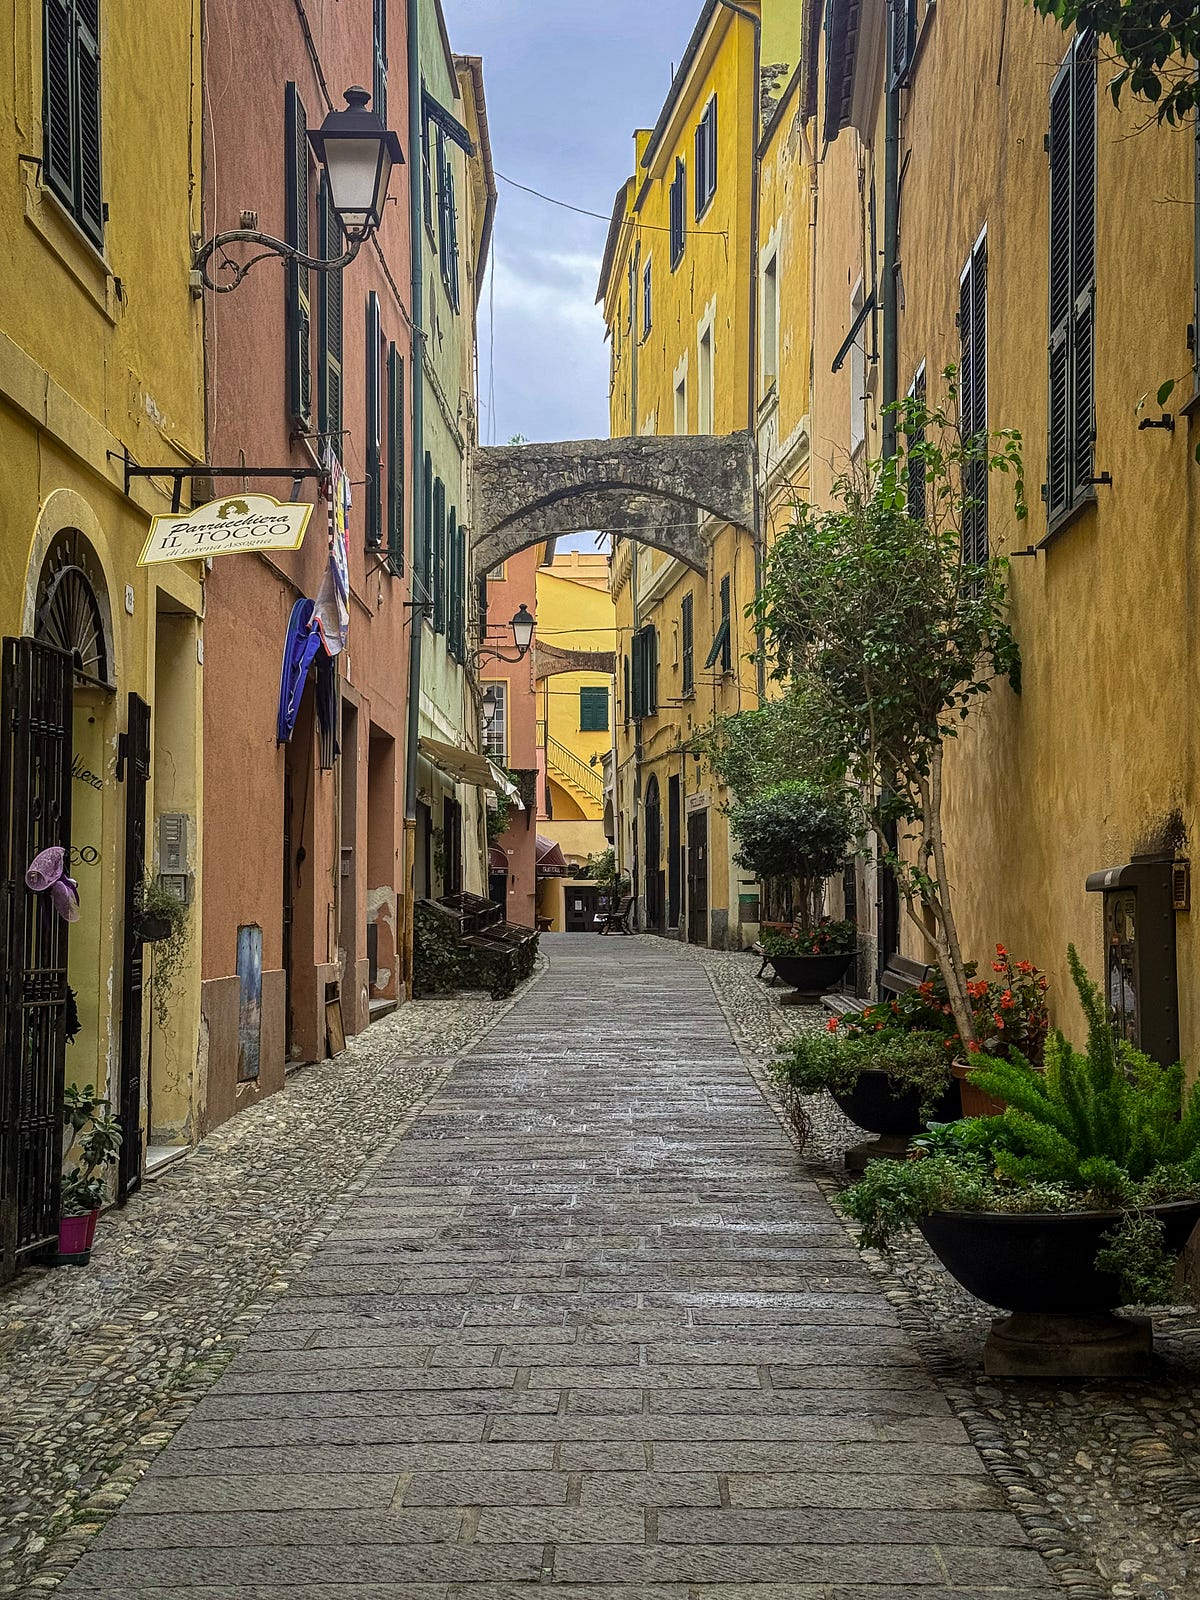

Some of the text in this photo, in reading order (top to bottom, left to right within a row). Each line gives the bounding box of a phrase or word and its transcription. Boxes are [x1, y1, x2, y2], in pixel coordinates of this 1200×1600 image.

[159, 523, 291, 550] IL TOCCO
[168, 513, 289, 537] Parrucchiera
[166, 548, 178, 557] di
[180, 544, 222, 555] Lorena
